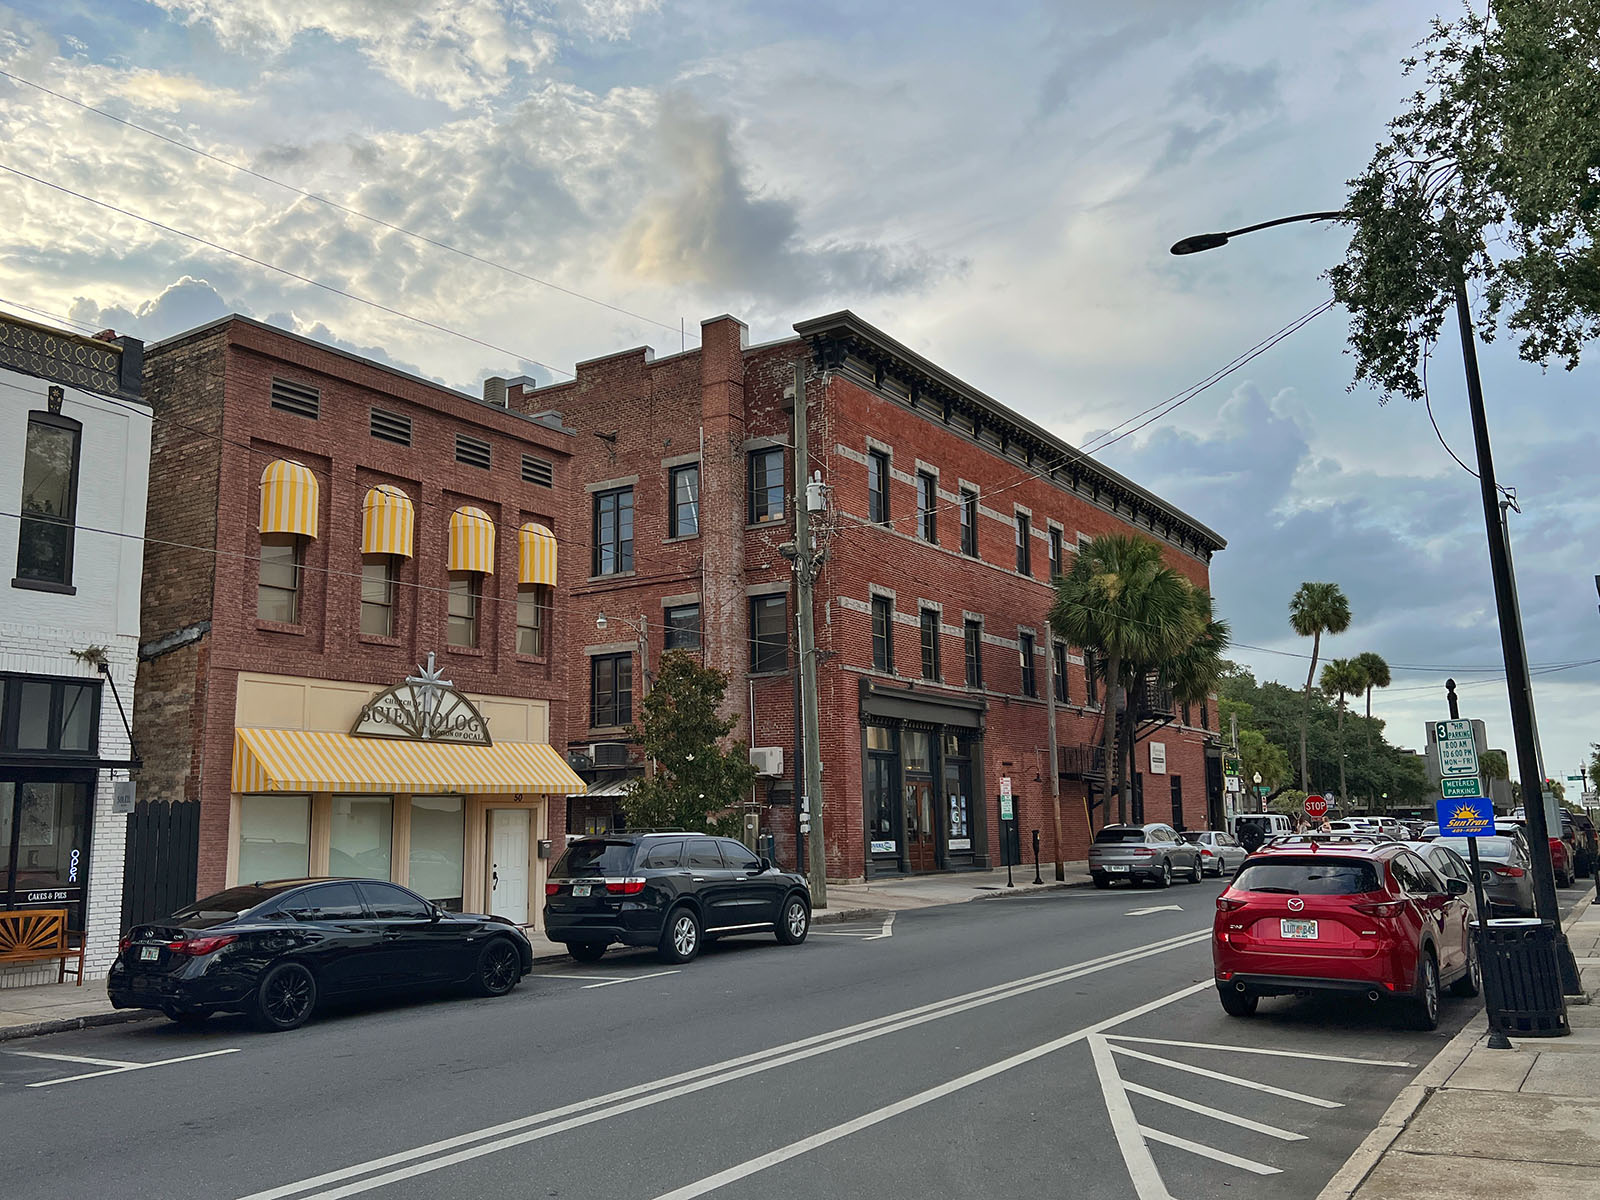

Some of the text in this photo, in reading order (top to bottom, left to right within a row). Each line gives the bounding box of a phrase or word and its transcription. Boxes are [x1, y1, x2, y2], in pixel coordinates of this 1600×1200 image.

[361, 704, 491, 732] SCIENTOLOGY
[1454, 722, 1464, 730] HR
[1438, 724, 1447, 738] 3
[1448, 731, 1471, 739] PARKING
[1445, 740, 1467, 749] 8:00 AM
[1443, 750, 1449, 758] TO
[1447, 787, 1476, 795] PARKING
[514, 794, 522, 802] 50
[1305, 801, 1326, 811] STOP
[28, 891, 67, 901] CAKES & PIES
